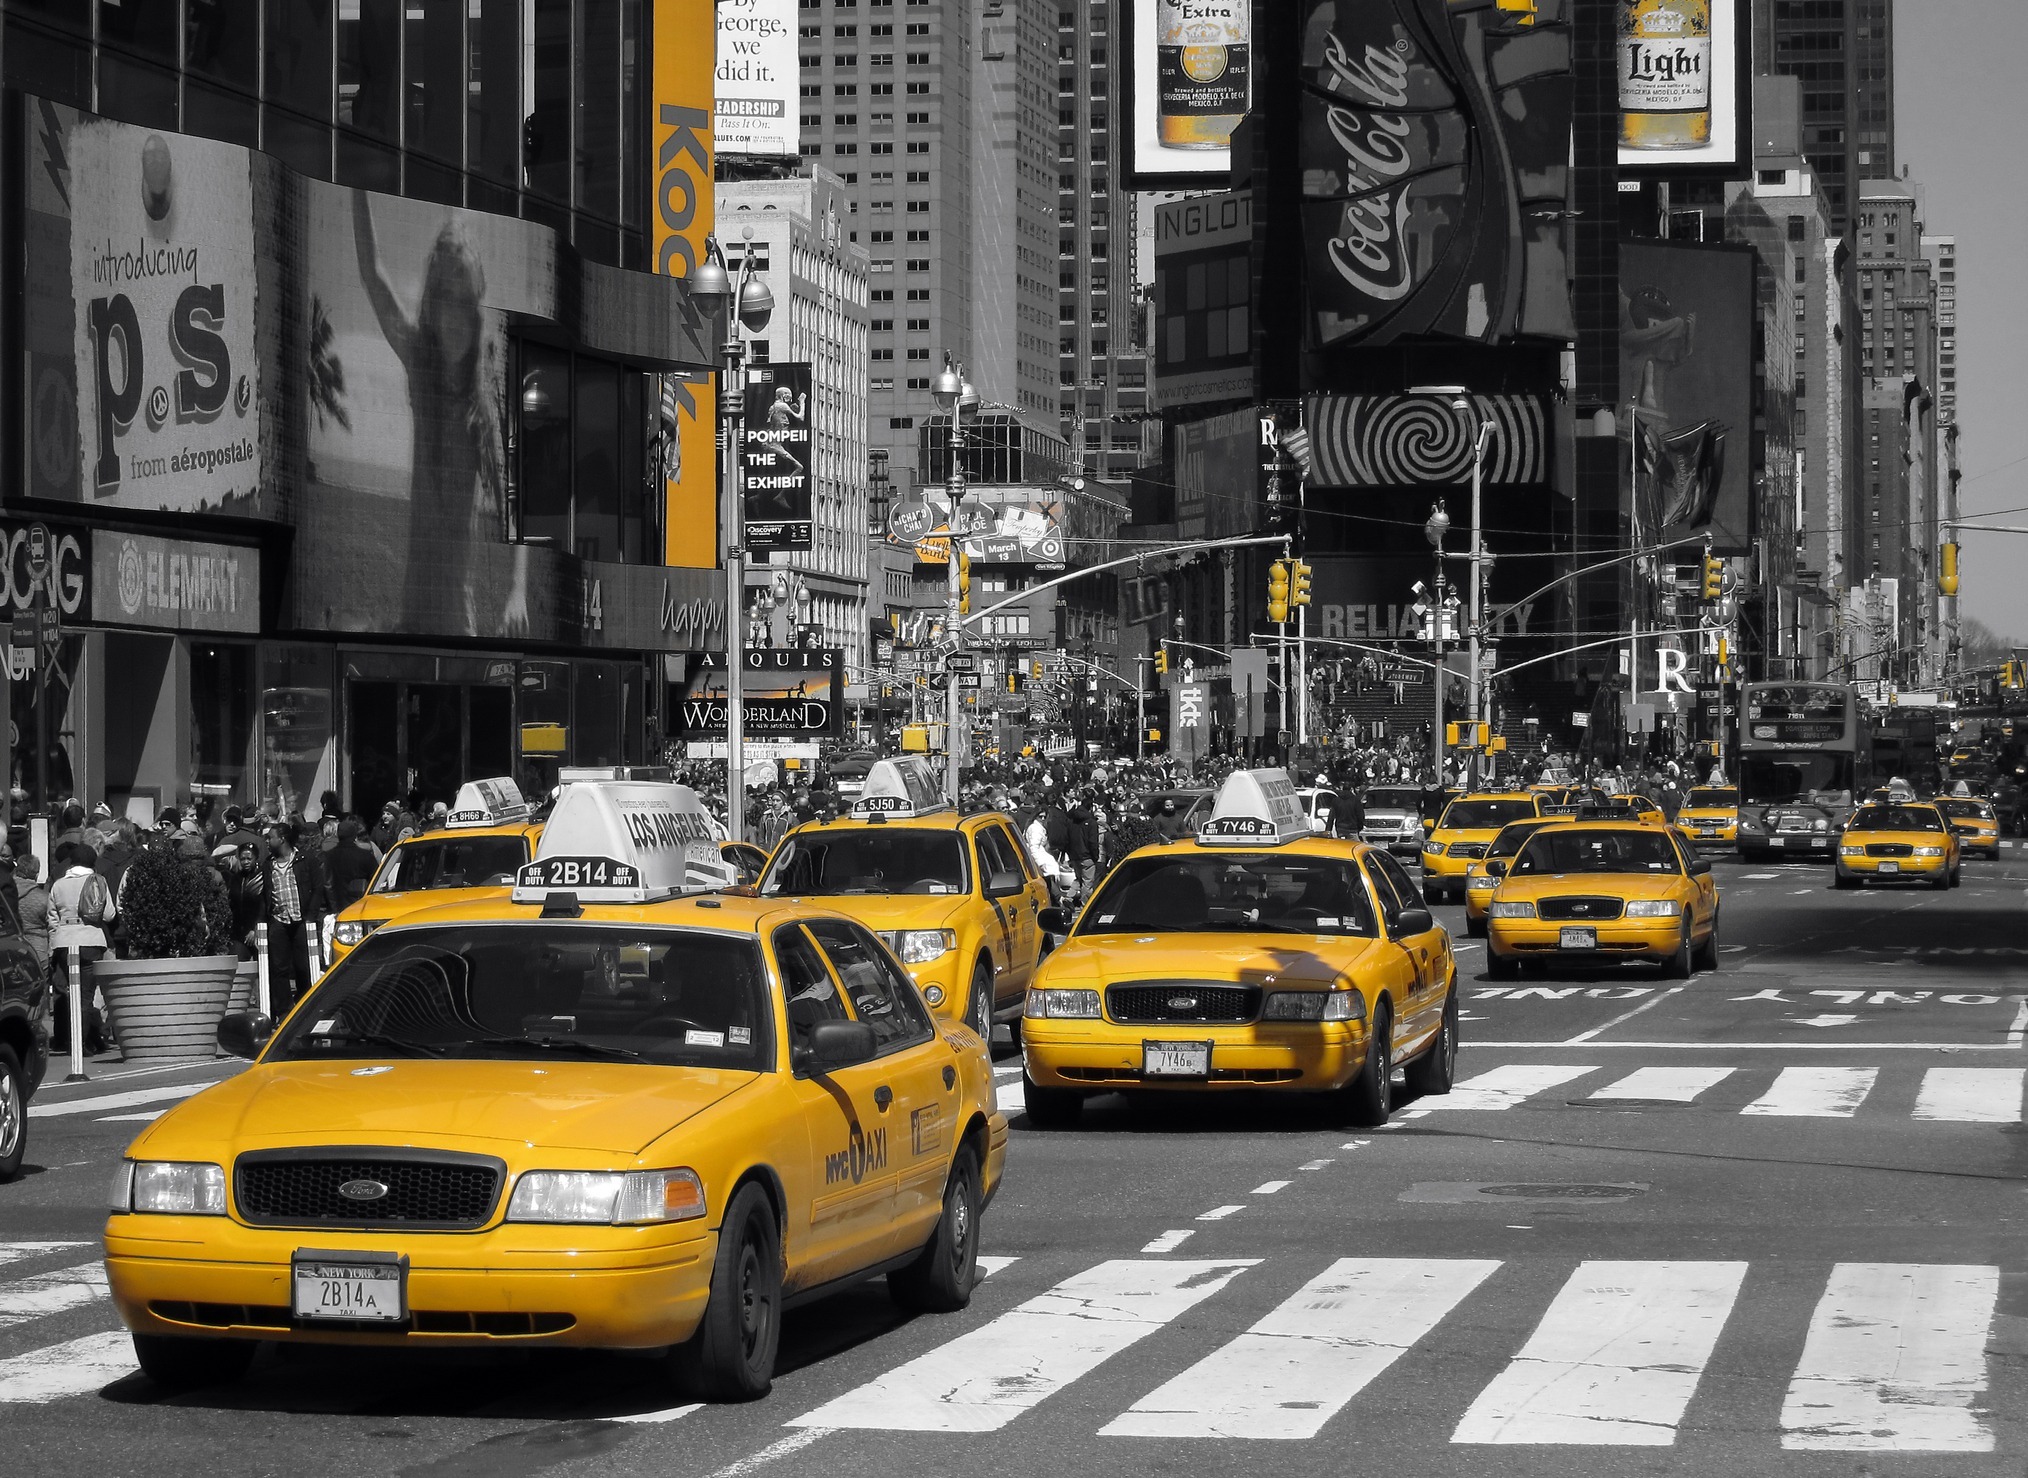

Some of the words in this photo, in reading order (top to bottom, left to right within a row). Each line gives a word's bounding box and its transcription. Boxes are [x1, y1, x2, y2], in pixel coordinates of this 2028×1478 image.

[1182, 5, 1232, 20] Extra
[732, 41, 761, 55] we
[1628, 44, 1701, 82] Light
[718, 60, 749, 82] did
[756, 62, 774, 82] it.
[714, 100, 780, 115] EADERSHIP
[721, 119, 740, 129] Pass
[1156, 197, 1250, 241] INGLOT
[94, 238, 198, 286] introducing
[747, 430, 808, 443] POMPEII
[131, 454, 167, 479] from
[171, 438, 253, 474] aéropostale
[747, 454, 776, 466] THE
[748, 476, 805, 489] EXHIBIT
[894, 508, 927, 526] ICHAD
[904, 521, 922, 533] CHAI
[988, 543, 1016, 553] March
[998, 553, 1009, 561] 13
[147, 551, 238, 614] ELEMENT
[43, 611, 57, 623] M20
[660, 578, 726, 650] happy
[1322, 603, 1534, 637] RELIATY
[43, 629, 58, 641] M104
[702, 653, 833, 667] AQUIS
[922, 651, 930, 661] 45
[1655, 649, 1696, 693] R
[1180, 687, 1202, 728] tkts
[869, 799, 894, 810] 5J50
[623, 813, 657, 848] LOS
[653, 813, 712, 847] ANGELES
[1222, 821, 1255, 833] 7Y46
[525, 876, 545, 885] DUTY
[528, 867, 542, 876] OFF
[550, 862, 607, 885] 2B14
[616, 867, 630, 876] OFF
[613, 876, 633, 885] DUTY
[1161, 1052, 1192, 1066] 7Y46B
[826, 1150, 848, 1184] NYC
[850, 1122, 887, 1179] TAXI
[350, 1184, 375, 1195] Ford
[322, 1268, 344, 1278] NEW
[348, 1268, 375, 1279] YORK
[321, 1281, 376, 1308] 2B14A
